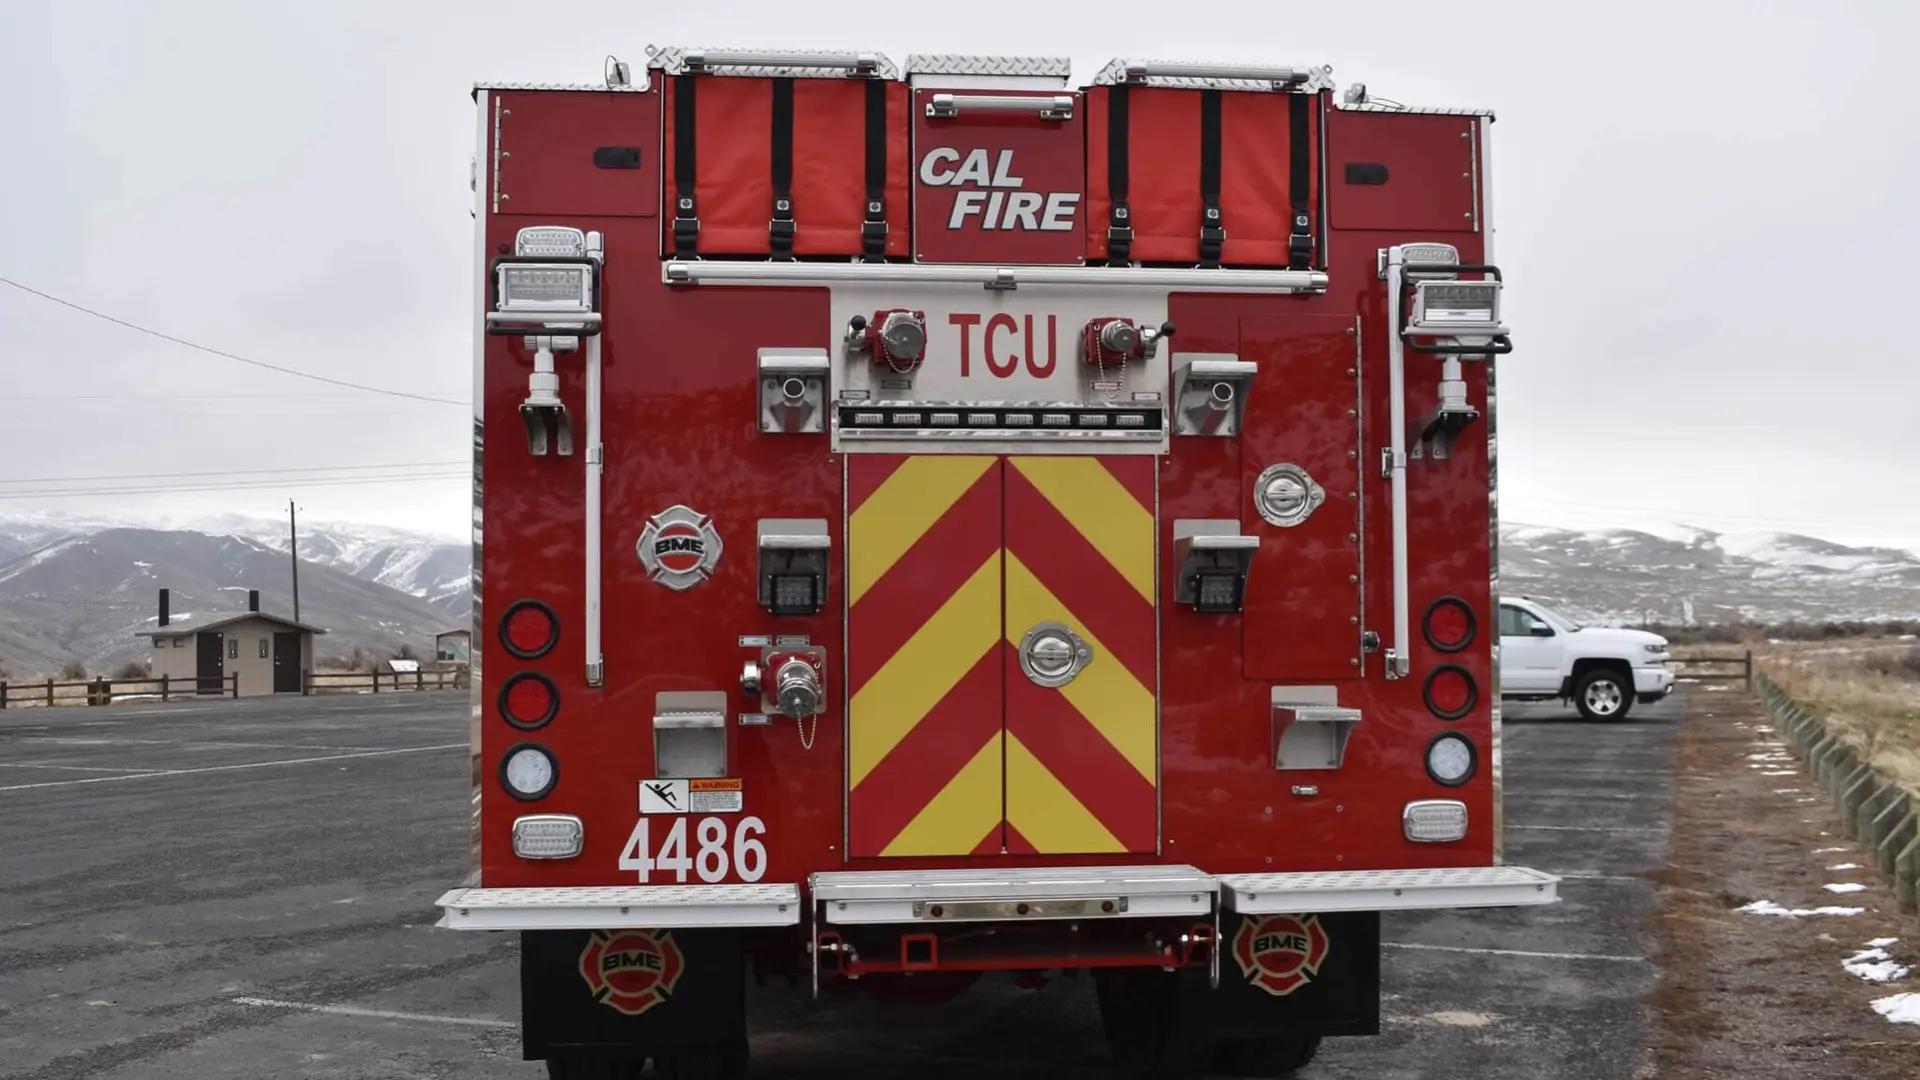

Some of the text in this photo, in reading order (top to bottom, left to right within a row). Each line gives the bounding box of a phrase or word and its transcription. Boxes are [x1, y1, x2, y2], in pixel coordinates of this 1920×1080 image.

[920, 147, 1024, 187] CAL
[948, 191, 1080, 230] FIRE
[949, 313, 1056, 378] TCU
[655, 538, 704, 555] BME
[702, 781, 740, 789] WARNING
[618, 816, 767, 883] 4486
[1254, 934, 1308, 954] BME
[603, 951, 661, 972] BME
